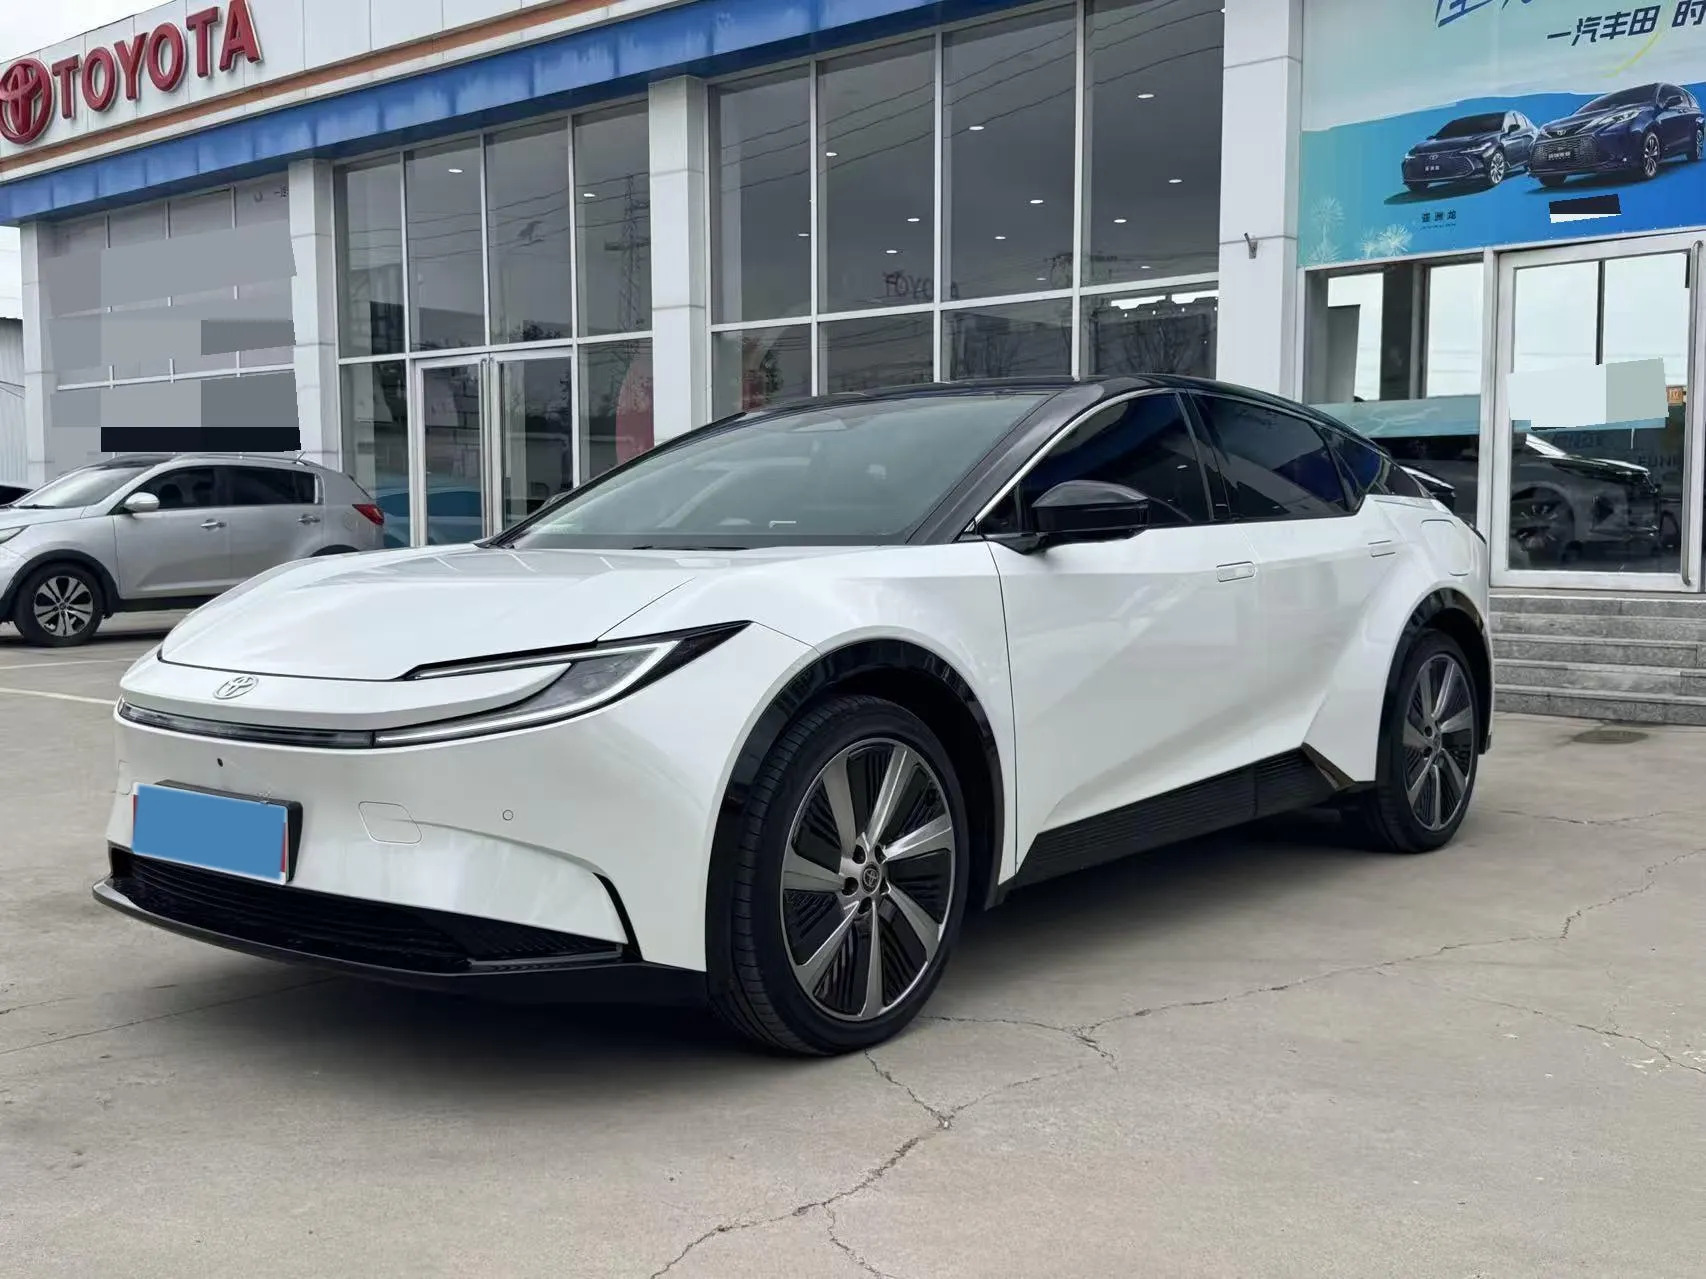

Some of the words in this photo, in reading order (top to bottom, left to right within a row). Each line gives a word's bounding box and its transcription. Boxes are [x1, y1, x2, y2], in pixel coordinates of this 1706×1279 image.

[52, 0, 262, 119] TOYOTA
[1547, 5, 1661, 46] 一汽丰田
